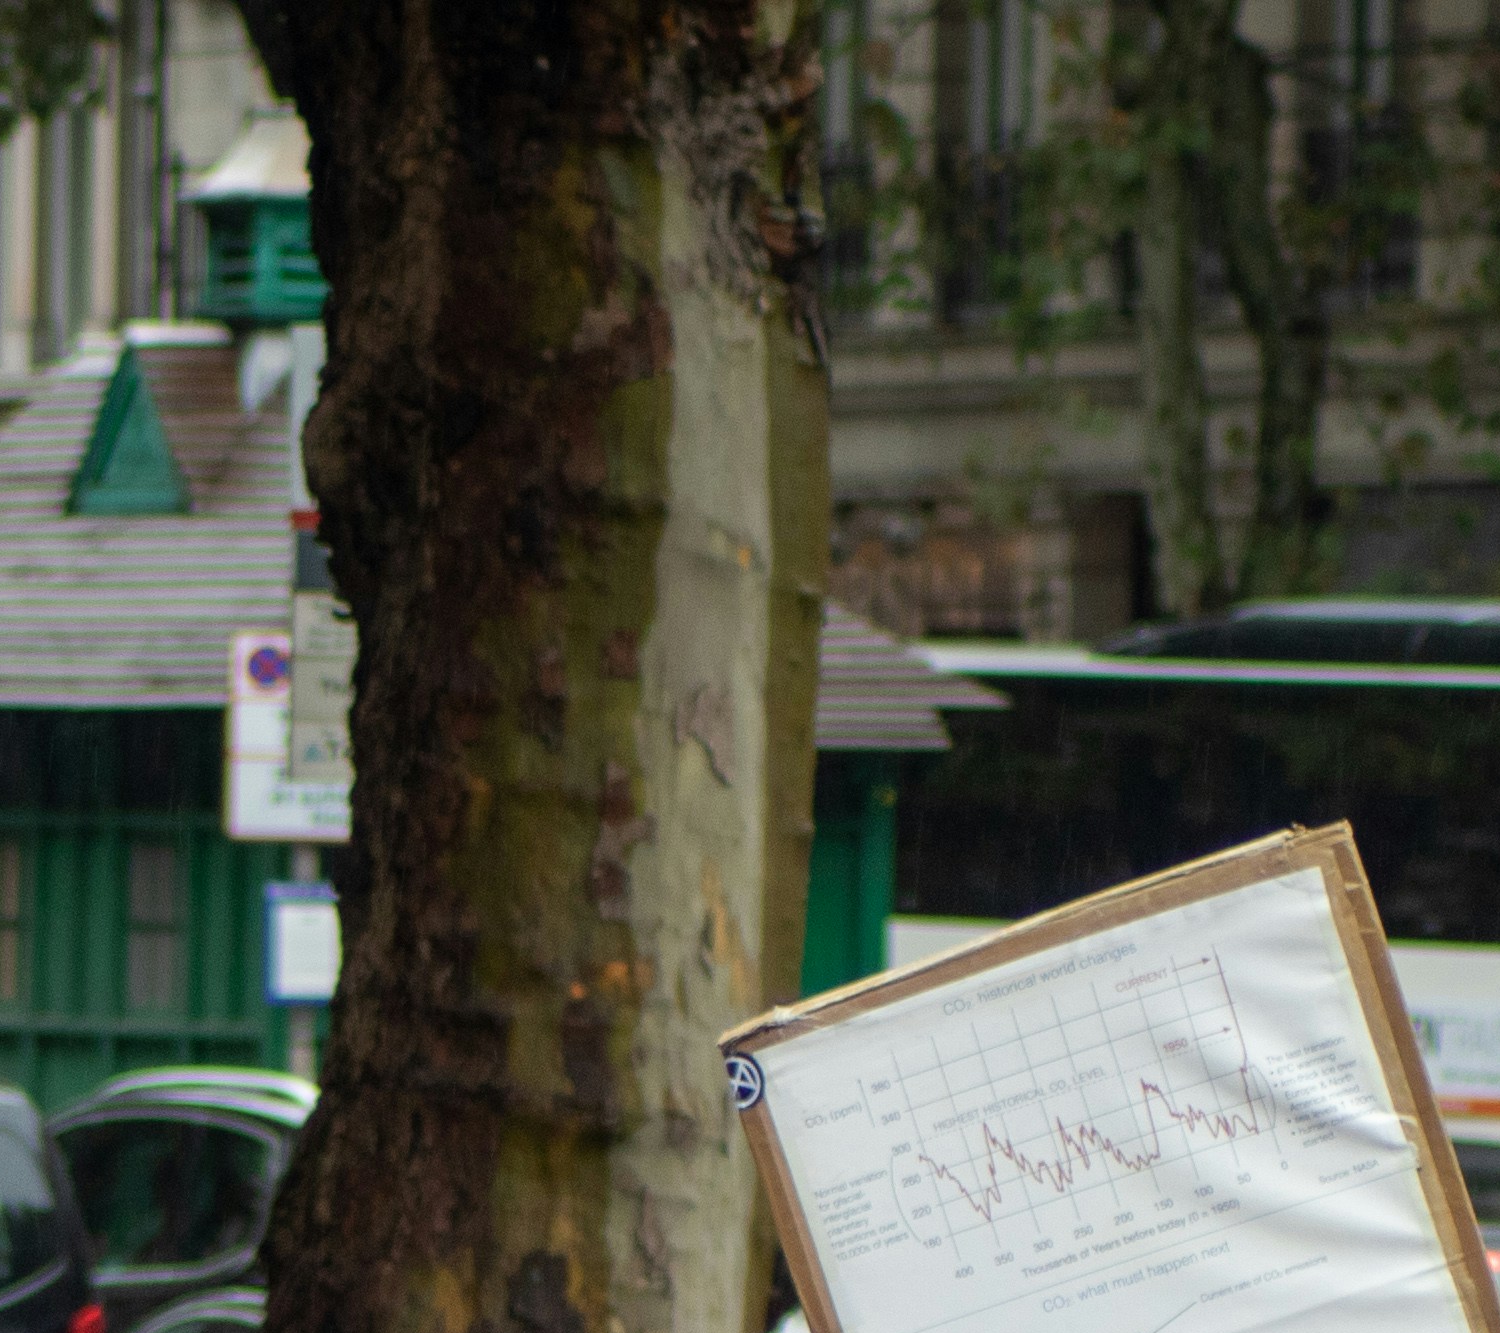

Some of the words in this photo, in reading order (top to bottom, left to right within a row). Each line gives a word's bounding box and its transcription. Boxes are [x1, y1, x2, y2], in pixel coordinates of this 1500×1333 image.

[976, 974, 1038, 1004] historical
[1038, 960, 1076, 983] world
[1078, 942, 1138, 970] changes
[1113, 967, 1169, 993] CURRENT
[1161, 1036, 1189, 1054] 1950
[870, 1079, 891, 1094] 380
[1284, 1083, 1316, 1100] Europe
[1328, 1072, 1354, 1085] North
[828, 1100, 864, 1122] (ppm)
[932, 1108, 981, 1132] HIGHEST
[981, 1085, 1046, 1115] HISTORICAL
[1071, 1066, 1105, 1084] LEVEL
[881, 1111, 901, 1125] 340
[890, 1141, 912, 1156] 300
[1352, 1158, 1379, 1173] NASA
[813, 1181, 848, 1198] Normal
[848, 1168, 888, 1187] variation
[818, 1201, 831, 1210] for
[821, 1200, 873, 1224] interglacial
[910, 1204, 932, 1219] 220
[826, 1217, 870, 1238] planetary
[953, 1265, 974, 1279] 400
[993, 1251, 1015, 1266] 350
[1032, 1238, 1054, 1253] 300
[1072, 1224, 1094, 1239] 250
[1113, 1211, 1134, 1226] 200
[1153, 1198, 1174, 1212] 150
[1194, 1184, 1214, 1198] 100
[1236, 1172, 1252, 1185] 50
[1280, 1160, 1288, 1170] 0
[830, 1228, 877, 1249] transitions
[878, 1221, 898, 1233] over
[872, 1239, 883, 1249] of
[883, 1231, 910, 1249] years
[1020, 1252, 1079, 1279] Thousands
[1078, 1248, 1091, 1259] of
[1091, 1237, 1121, 1255] Years
[1122, 1226, 1156, 1244] before
[1156, 1215, 1187, 1235] today
[1209, 1197, 1241, 1216] 1950)
[1076, 1280, 1110, 1301] what
[1111, 1268, 1145, 1289] must
[1145, 1250, 1199, 1279] happen
[1200, 1241, 1230, 1260] next
[1199, 1285, 1233, 1303] Current
[1233, 1279, 1251, 1292] rate
[1253, 1275, 1262, 1285] of
[1283, 1254, 1328, 1274] emissions
